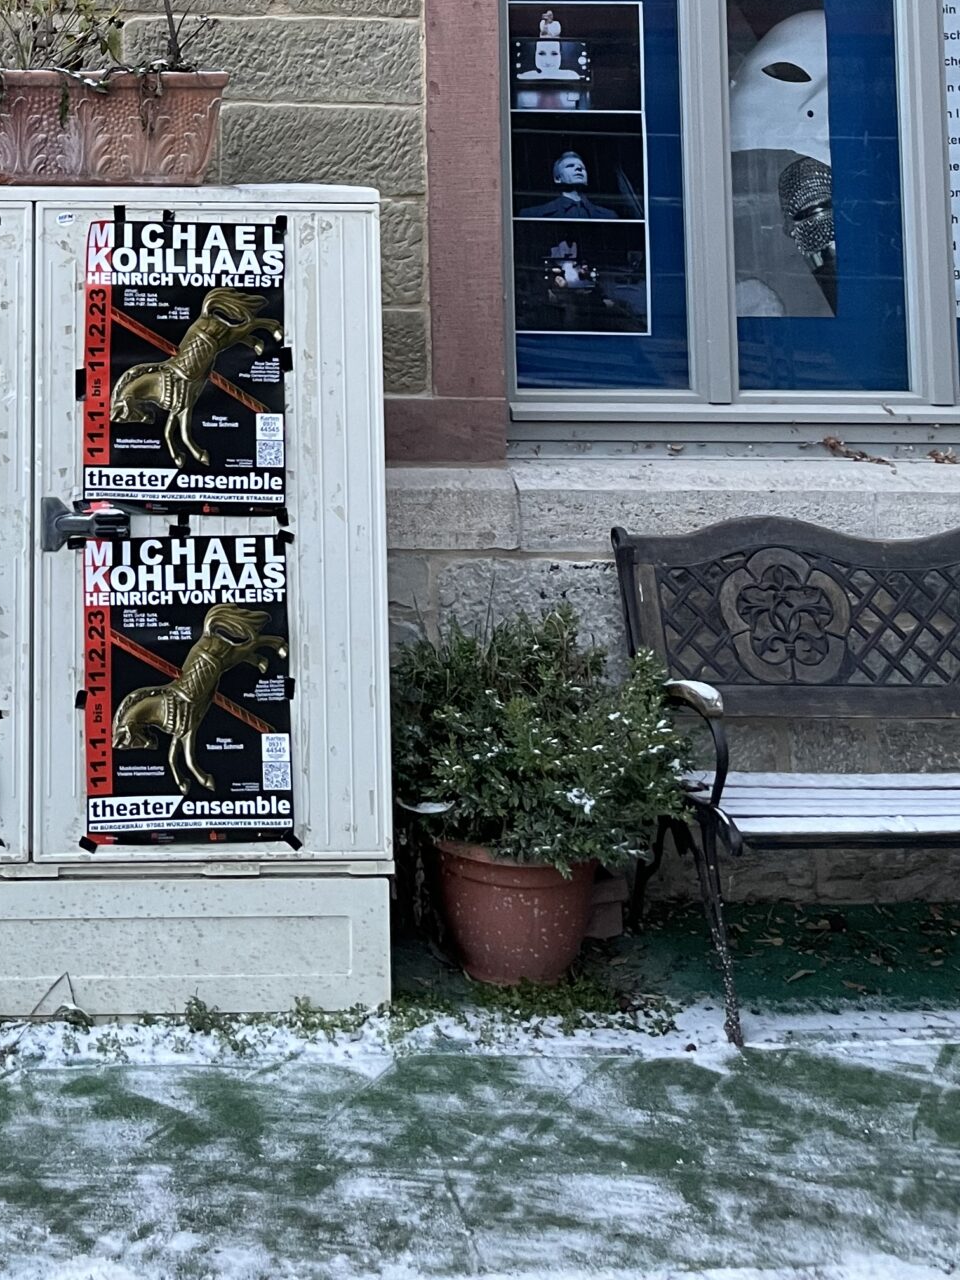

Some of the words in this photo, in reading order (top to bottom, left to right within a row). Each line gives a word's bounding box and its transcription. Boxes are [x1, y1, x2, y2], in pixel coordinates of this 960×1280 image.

[90, 223, 284, 250] MICHAEL
[88, 247, 284, 274] KOHLHAAS
[88, 272, 172, 286] HEINRICH
[178, 273, 215, 287] VON
[221, 274, 283, 287] KLEIST
[89, 289, 106, 370] 11.2.23
[92, 379, 101, 397] bis
[88, 470, 168, 487] theater
[177, 472, 282, 489] ensemble
[86, 538, 285, 566] MICHAEL
[86, 563, 285, 592] KOHLHAAS
[86, 590, 173, 606] HEINRICH
[178, 590, 216, 604] VON
[221, 589, 285, 602] KLEIST
[89, 611, 105, 695] 11.2.23
[94, 703, 102, 722] bis
[91, 799, 173, 817] theater
[182, 796, 290, 814] ensemble
